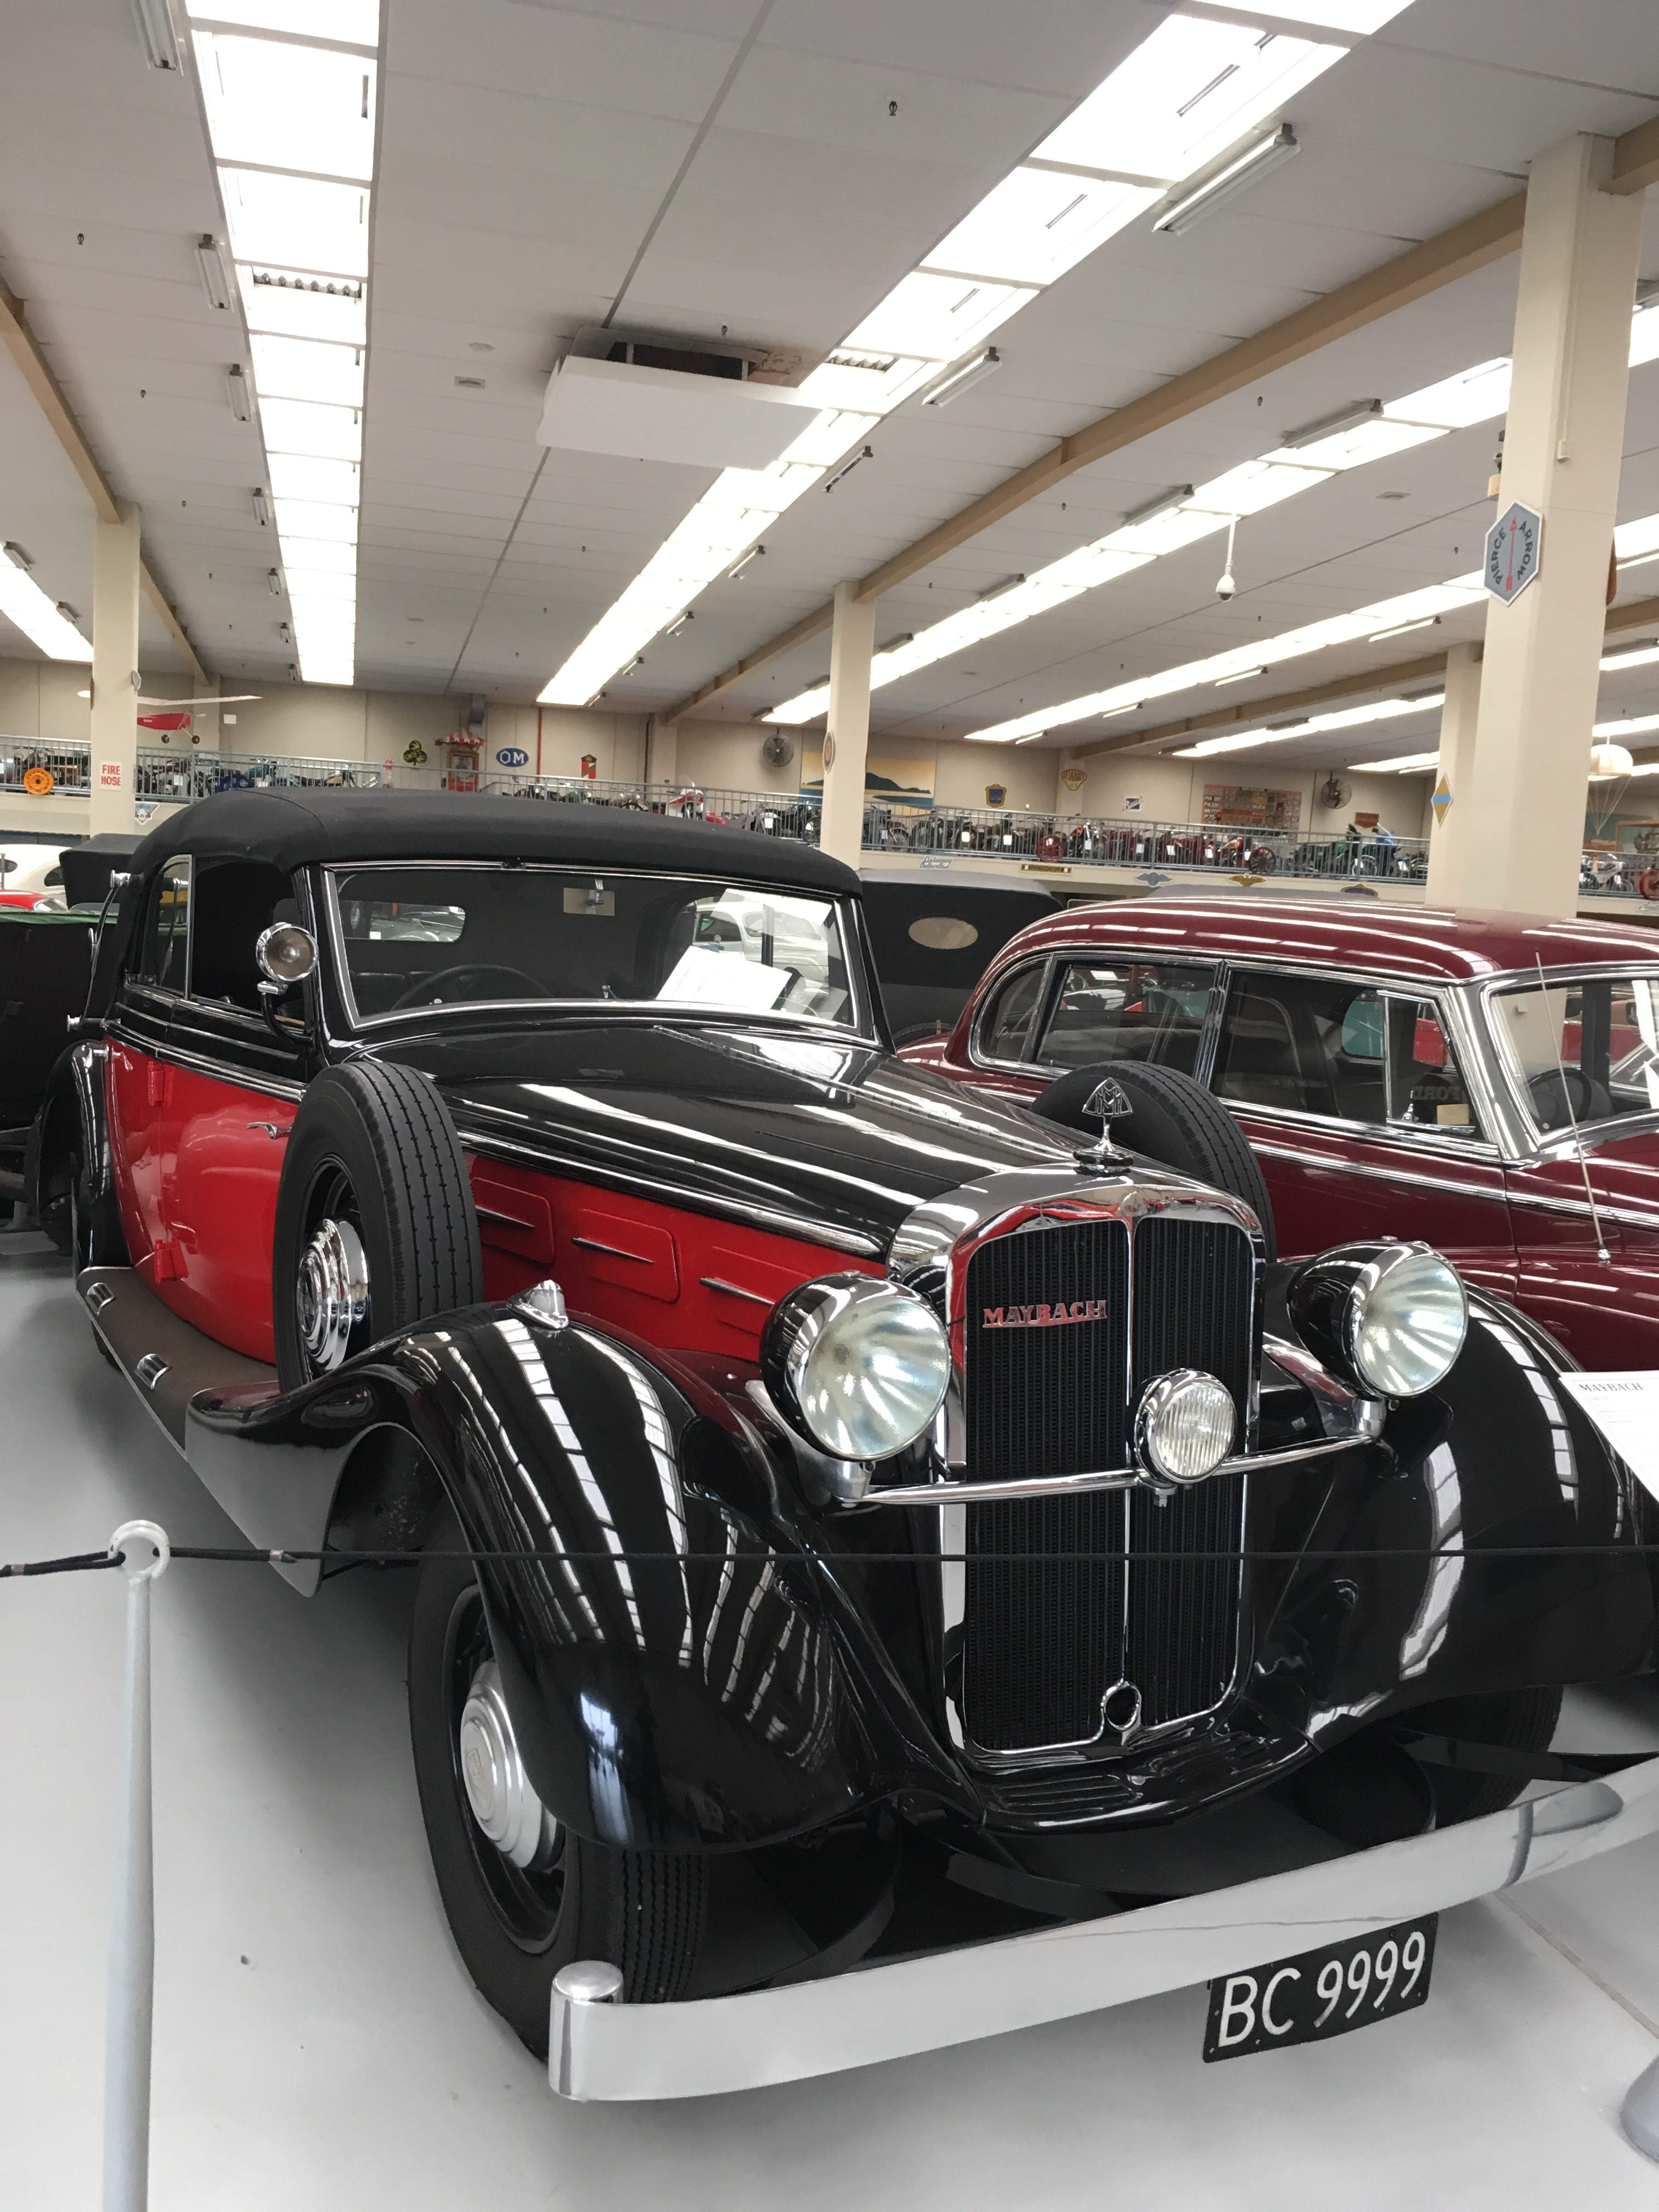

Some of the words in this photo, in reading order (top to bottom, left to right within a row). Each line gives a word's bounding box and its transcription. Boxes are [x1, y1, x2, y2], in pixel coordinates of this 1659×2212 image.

[1491, 527, 1506, 585] PIERCE
[1518, 521, 1533, 580] ARROW
[500, 751, 524, 764] OM
[101, 764, 121, 775] FIRE
[100, 776, 122, 786] HOSE
[983, 1300, 1107, 1327] MAYBACH
[1578, 1383, 1644, 1392] MAYBACH
[1218, 1967, 1301, 2047] BC
[1313, 1931, 1426, 2028] 9999
